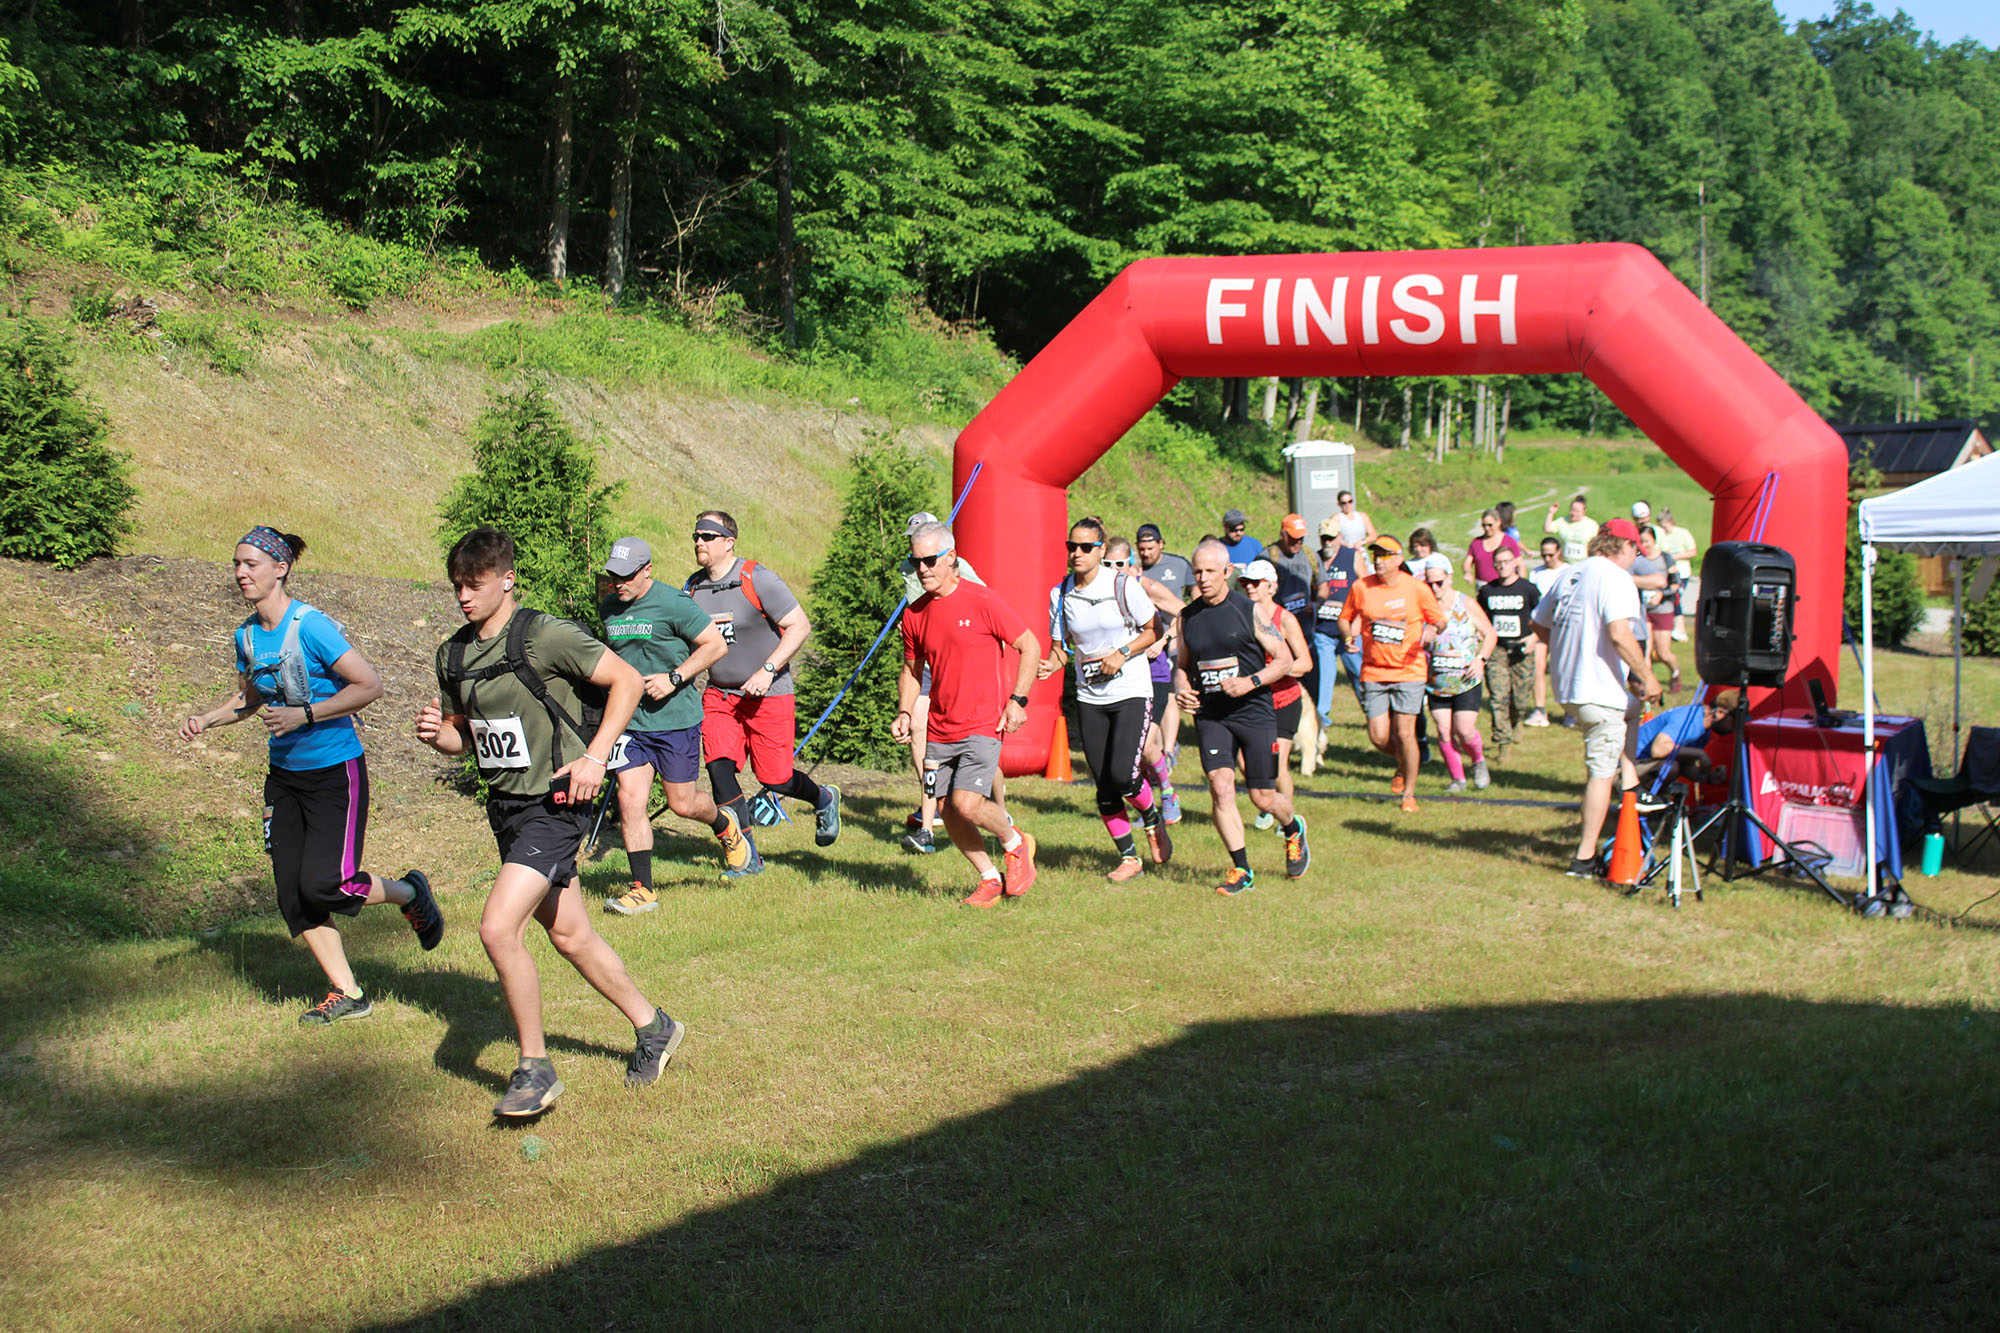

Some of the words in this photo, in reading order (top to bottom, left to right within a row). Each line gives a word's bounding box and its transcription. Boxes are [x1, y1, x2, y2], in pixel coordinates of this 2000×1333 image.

[1206, 274, 1518, 345] FINISH
[1487, 595, 1525, 610] USMC
[606, 624, 653, 636] TRIATHLON
[1496, 621, 1517, 632] 305
[296, 665, 306, 697] NATHAN
[1200, 666, 1239, 685] 2567
[476, 731, 521, 759] 302
